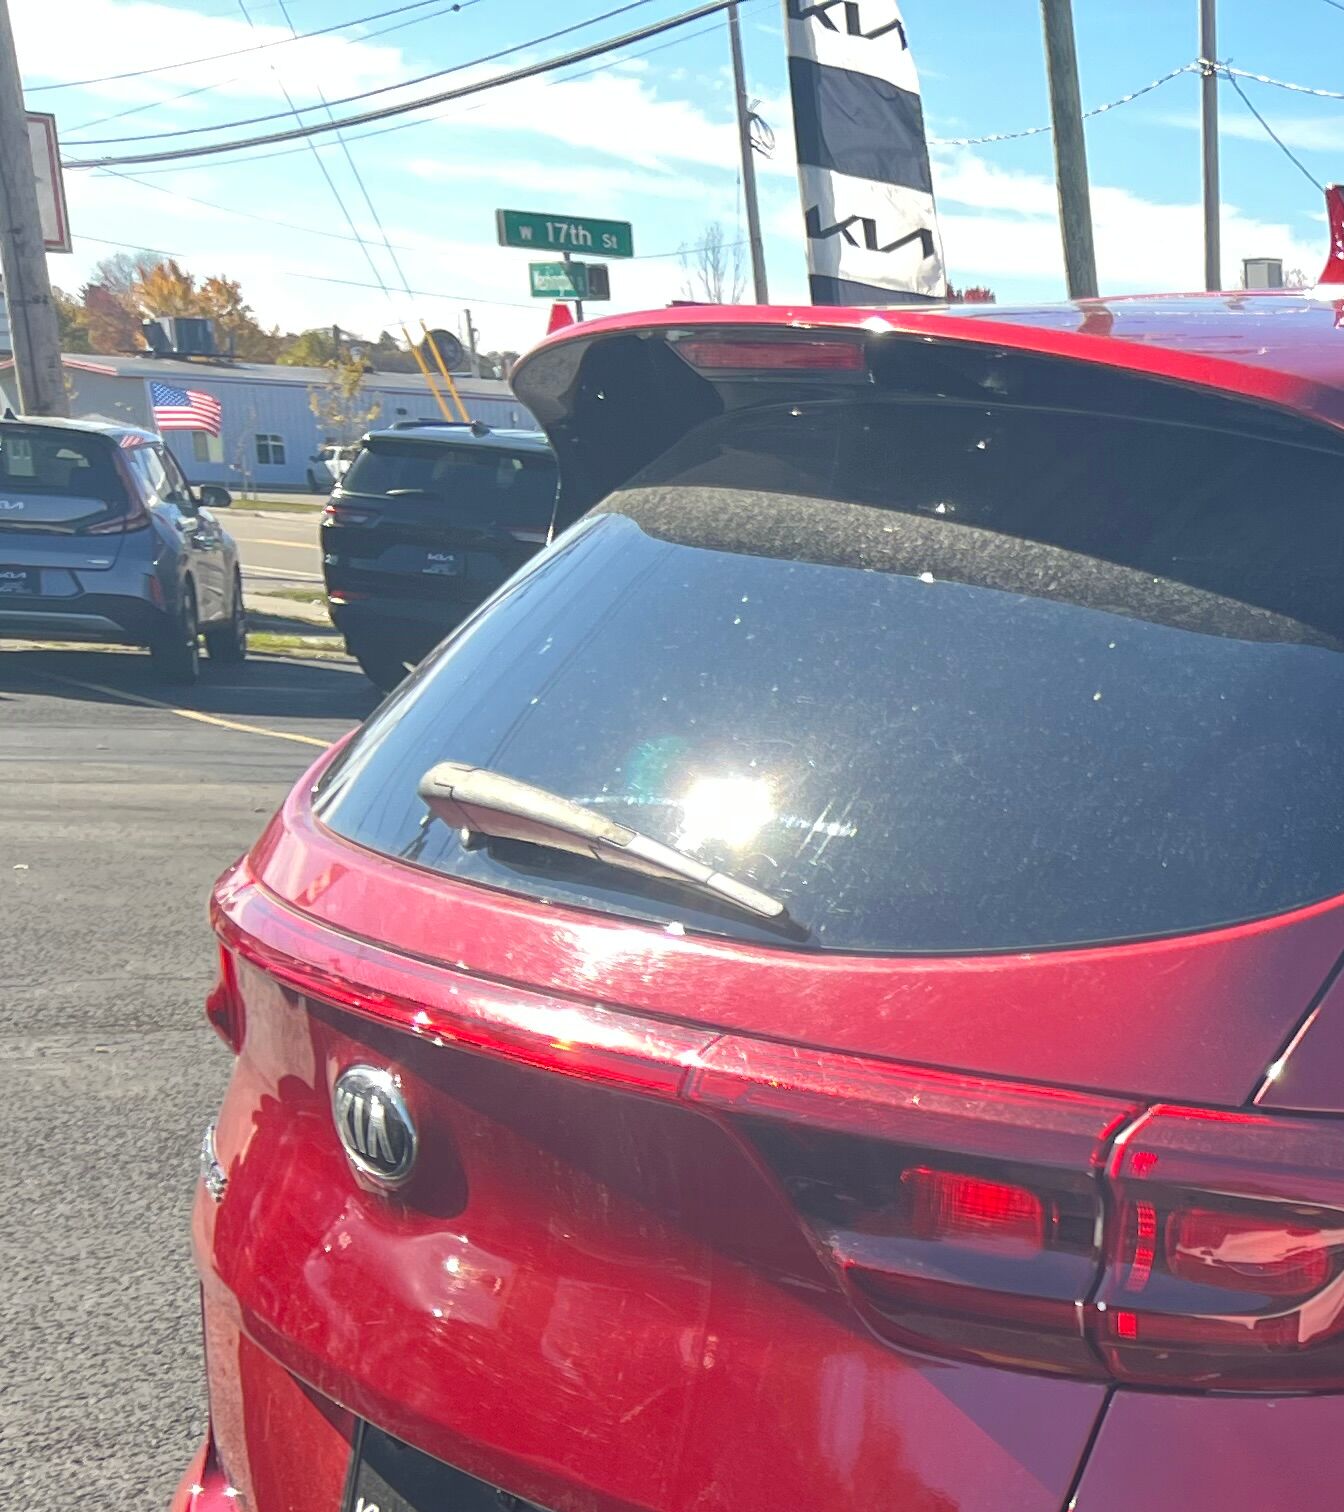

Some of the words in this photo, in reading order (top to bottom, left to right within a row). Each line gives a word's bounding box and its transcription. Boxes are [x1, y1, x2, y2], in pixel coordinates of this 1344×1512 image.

[519, 225, 533, 241] W
[545, 221, 592, 247] 17th
[601, 233, 618, 249] St
[805, 204, 935, 260] KIA
[335, 1086, 398, 1165] KIA
